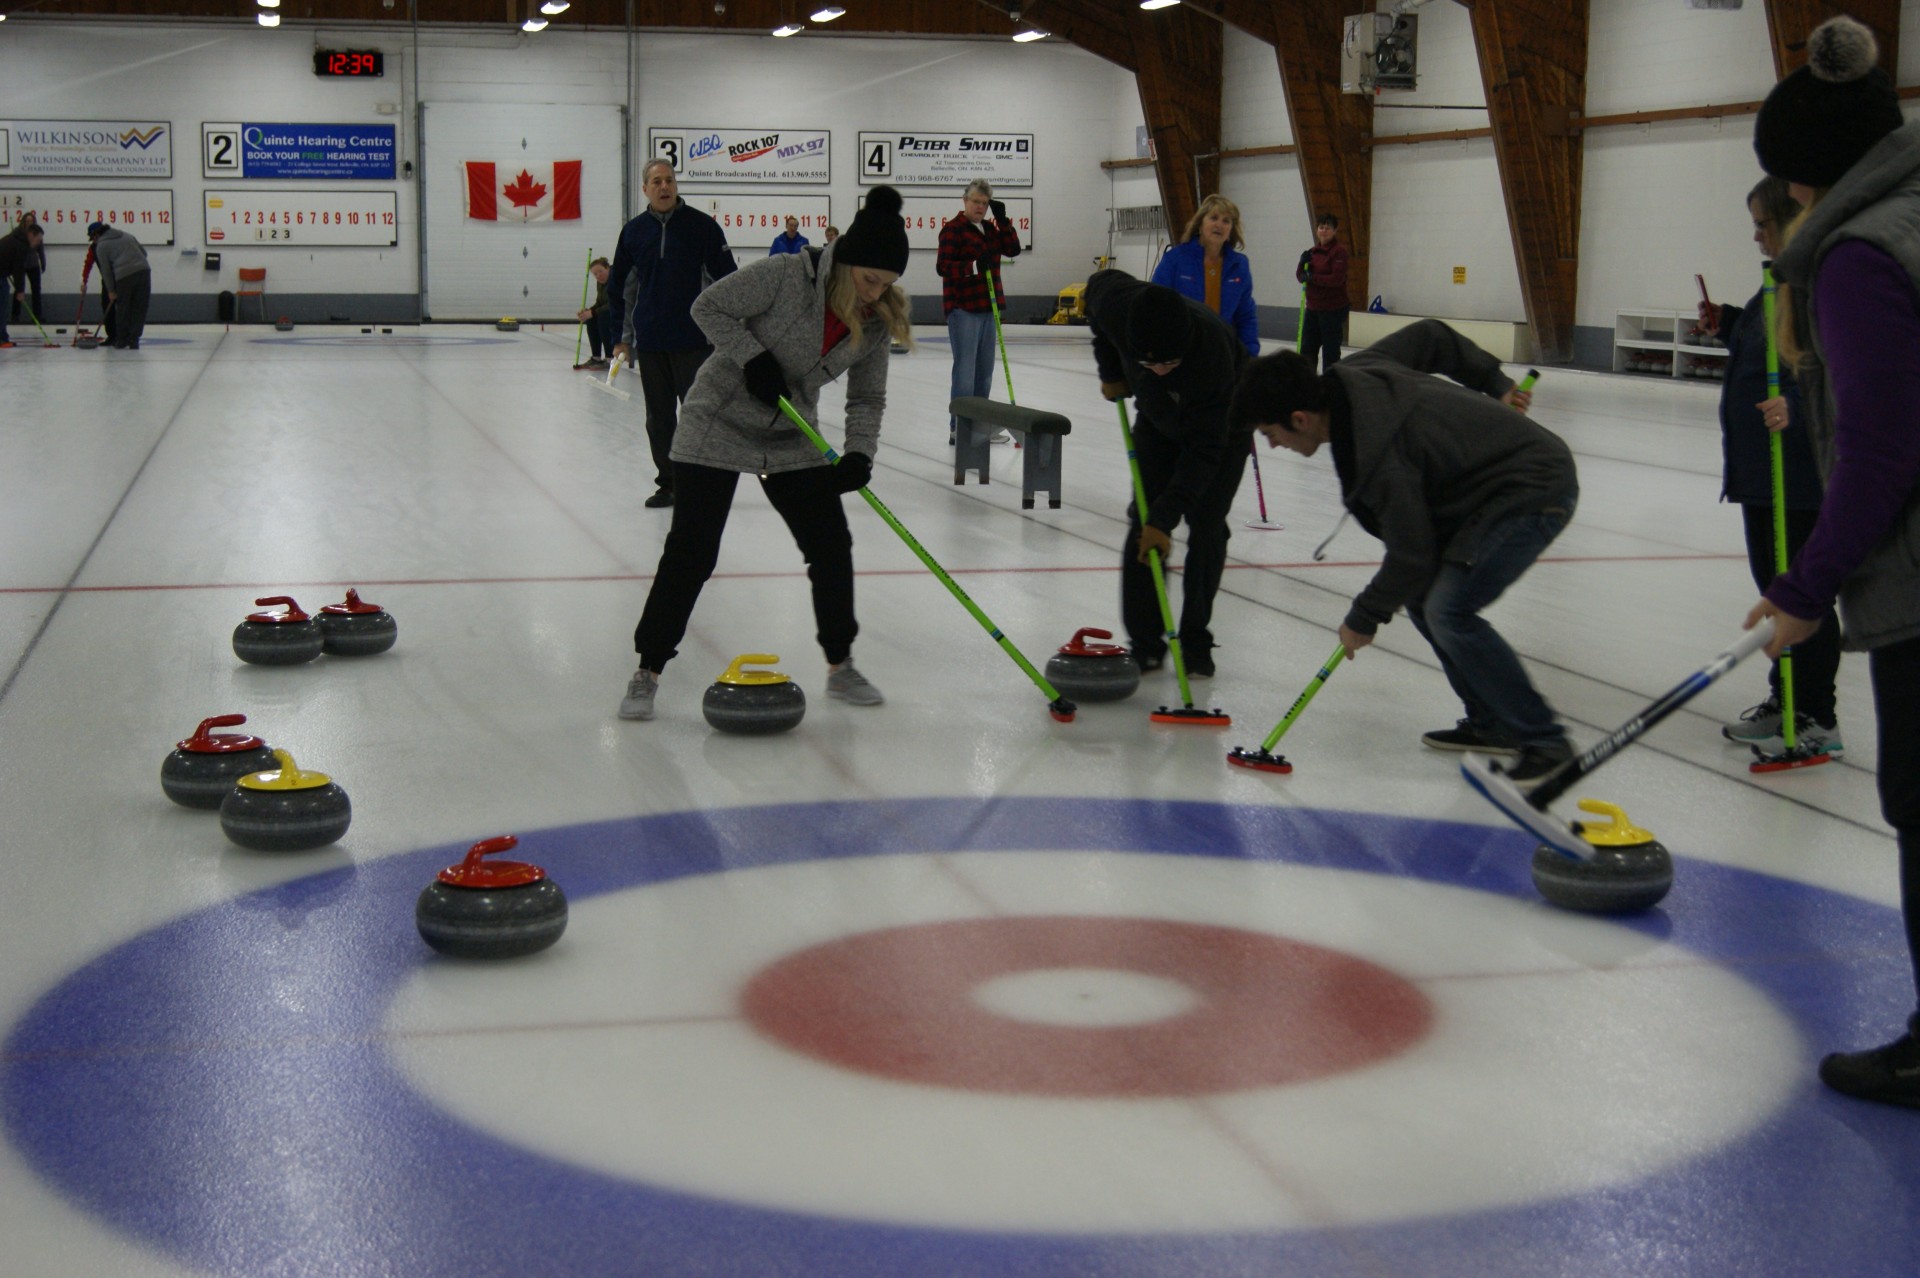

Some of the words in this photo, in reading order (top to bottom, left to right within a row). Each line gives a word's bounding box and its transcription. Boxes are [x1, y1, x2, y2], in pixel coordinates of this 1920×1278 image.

[329, 54, 374, 74] 12:39
[17, 131, 119, 145] WILKINSON
[244, 127, 295, 150] Quinte
[298, 135, 347, 149] Hearing
[350, 136, 392, 147] Centre
[898, 137, 950, 151] PETER
[958, 137, 1013, 151] SMITH
[213, 135, 232, 165] 2
[689, 134, 724, 159] CJBQ
[728, 139, 758, 156] ROCK
[762, 134, 780, 148] 107
[776, 143, 805, 159] MIX
[806, 138, 825, 151] 97
[84, 155, 92, 164] &
[247, 152, 273, 160] BOOK
[275, 152, 300, 160] YOUR
[302, 152, 324, 160] FREE
[327, 153, 366, 161] HEARING
[368, 153, 390, 161] TEST
[660, 140, 678, 168] 3
[868, 144, 885, 172] 4
[688, 169, 713, 178] Quinte
[715, 170, 762, 179] Broadcasting
[16, 196, 22, 205] 2
[2, 210, 8, 223] 1
[42, 210, 49, 223] 4
[57, 210, 63, 223] 5
[70, 210, 77, 223] 6
[84, 210, 90, 223] 7
[97, 210, 103, 222] 8
[110, 211, 116, 223] 9
[123, 211, 134, 223] 10
[141, 211, 151, 224] 11
[158, 211, 170, 224] 12
[231, 212, 236, 224] 1
[244, 212, 250, 224] 2
[258, 212, 264, 224] 3
[270, 212, 276, 224] 4
[284, 212, 290, 224] 5
[297, 212, 303, 224] 6
[310, 212, 316, 224] 7
[323, 212, 329, 224] 8
[335, 212, 341, 224] 9
[348, 212, 359, 224] 10
[366, 212, 376, 224] 11
[382, 212, 394, 224] 12
[725, 215, 730, 227] 5
[737, 215, 742, 227] 6
[749, 215, 755, 227] 7
[761, 215, 766, 227] 8
[773, 215, 778, 227] 9
[801, 215, 810, 227] 11
[817, 215, 827, 227] 12
[906, 217, 911, 229] 3
[917, 217, 923, 229] 4
[930, 217, 936, 229] 5
[1019, 218, 1029, 230] 12
[271, 230, 277, 239] 2
[284, 230, 290, 239] 3
